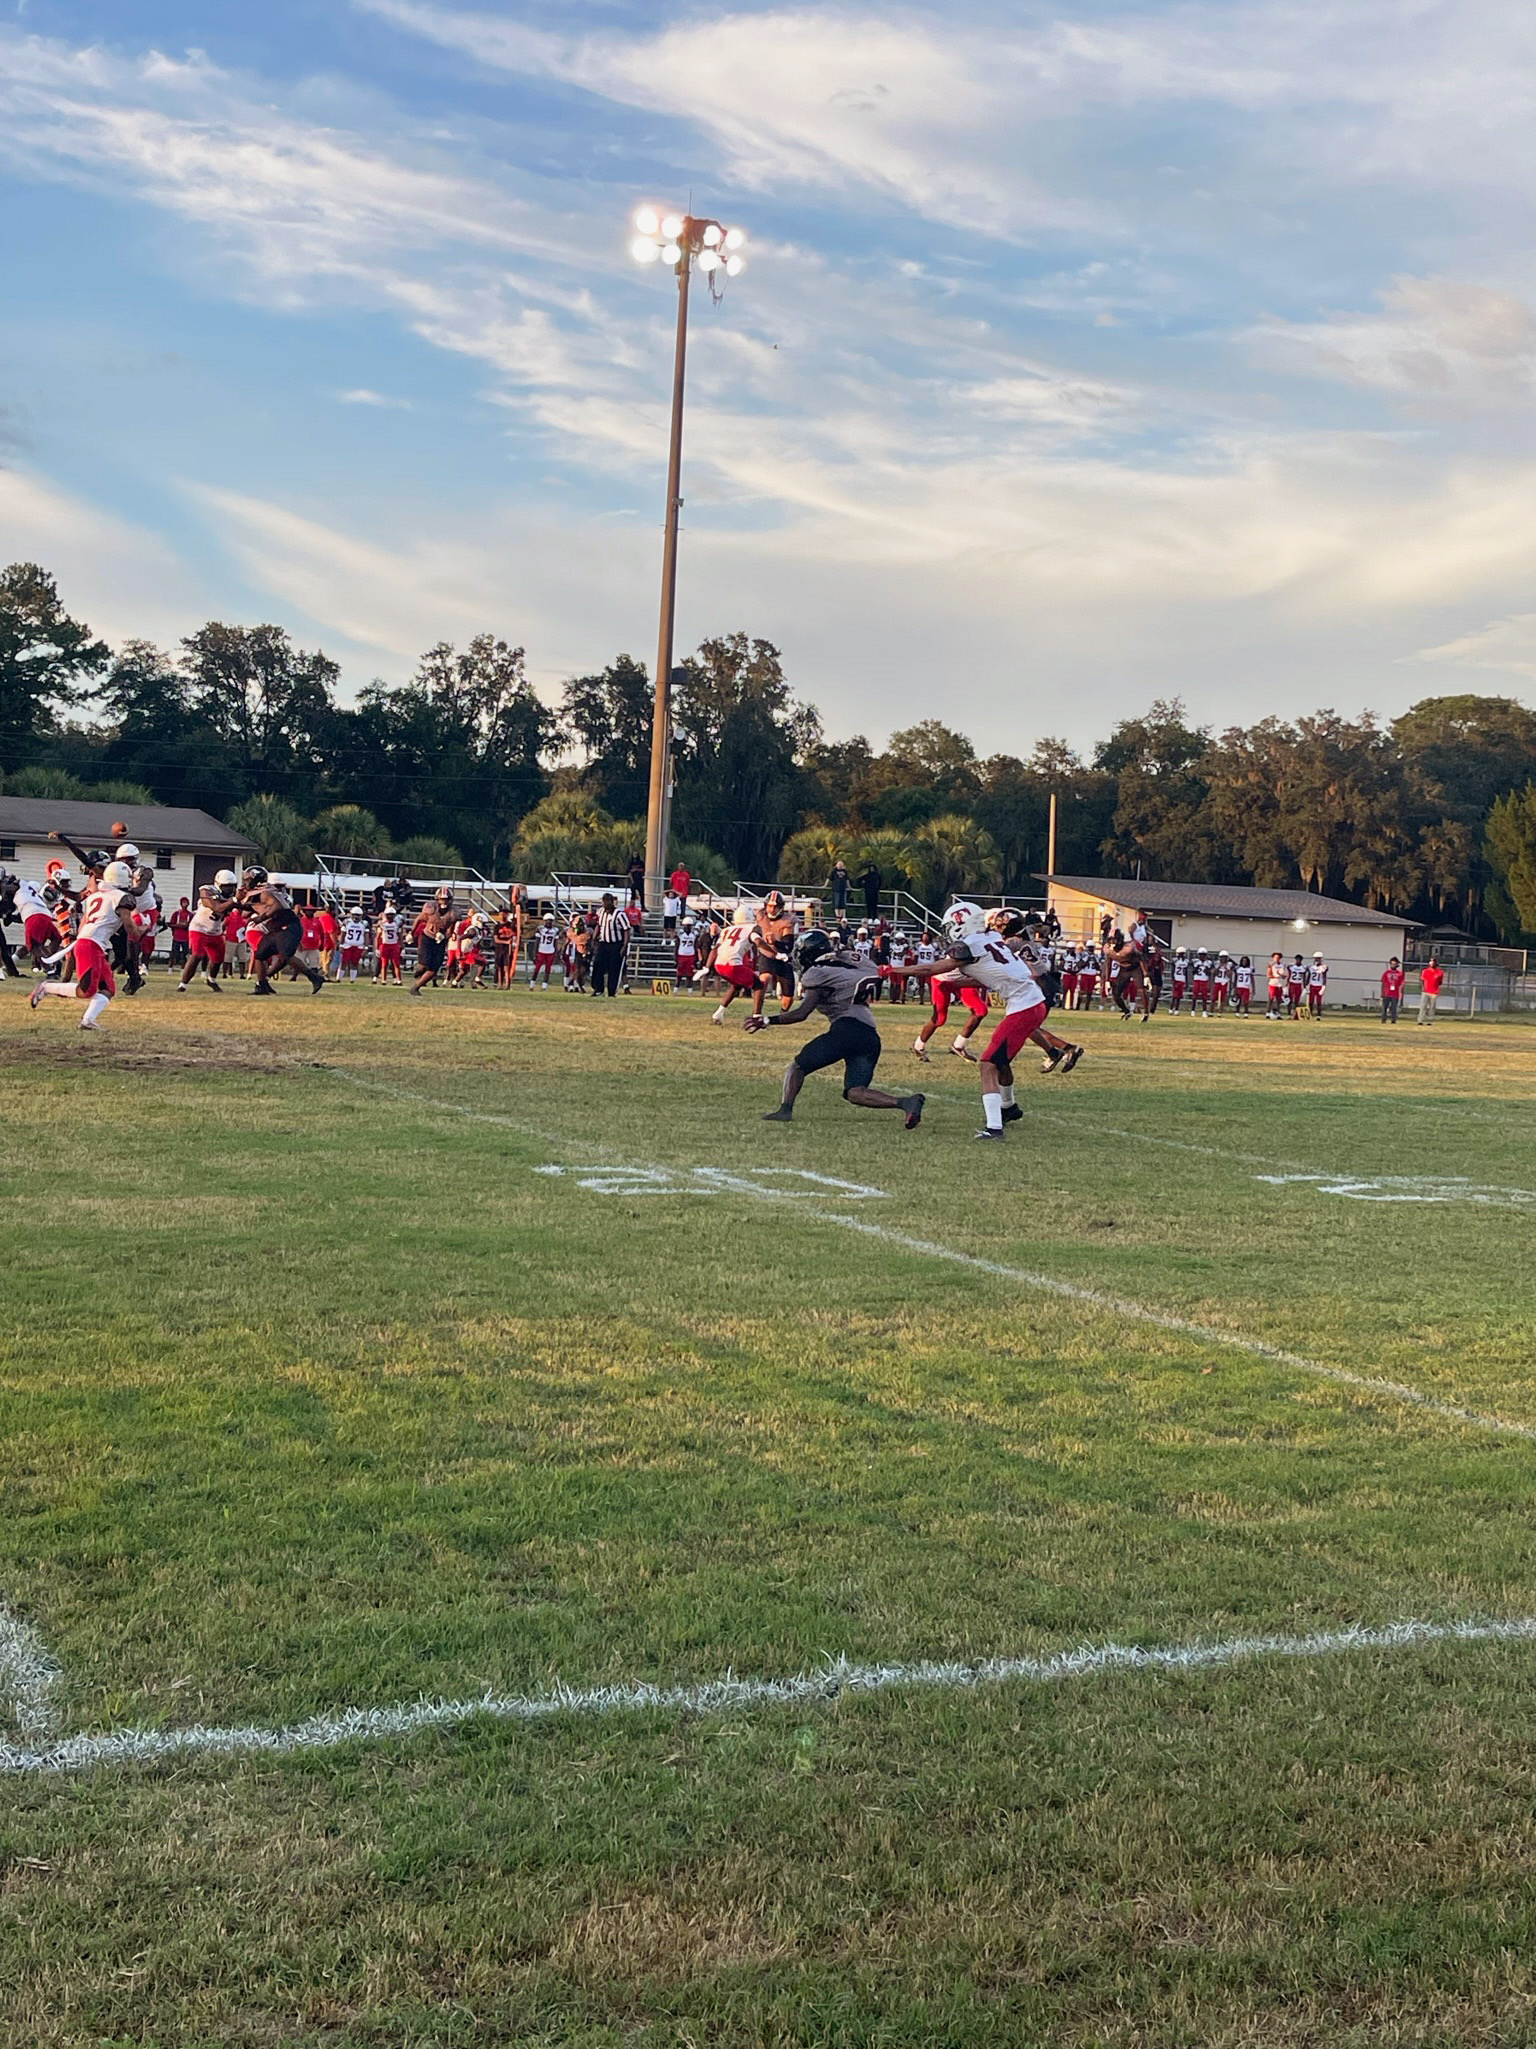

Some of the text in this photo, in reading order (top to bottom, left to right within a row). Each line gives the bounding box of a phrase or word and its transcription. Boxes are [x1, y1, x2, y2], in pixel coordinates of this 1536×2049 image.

[87, 897, 103, 924] 2
[347, 929, 362, 941] 57
[387, 929, 395, 940] 5
[722, 927, 743, 947] 14
[1238, 973, 1249, 983] 37
[656, 981, 669, 995] 40
